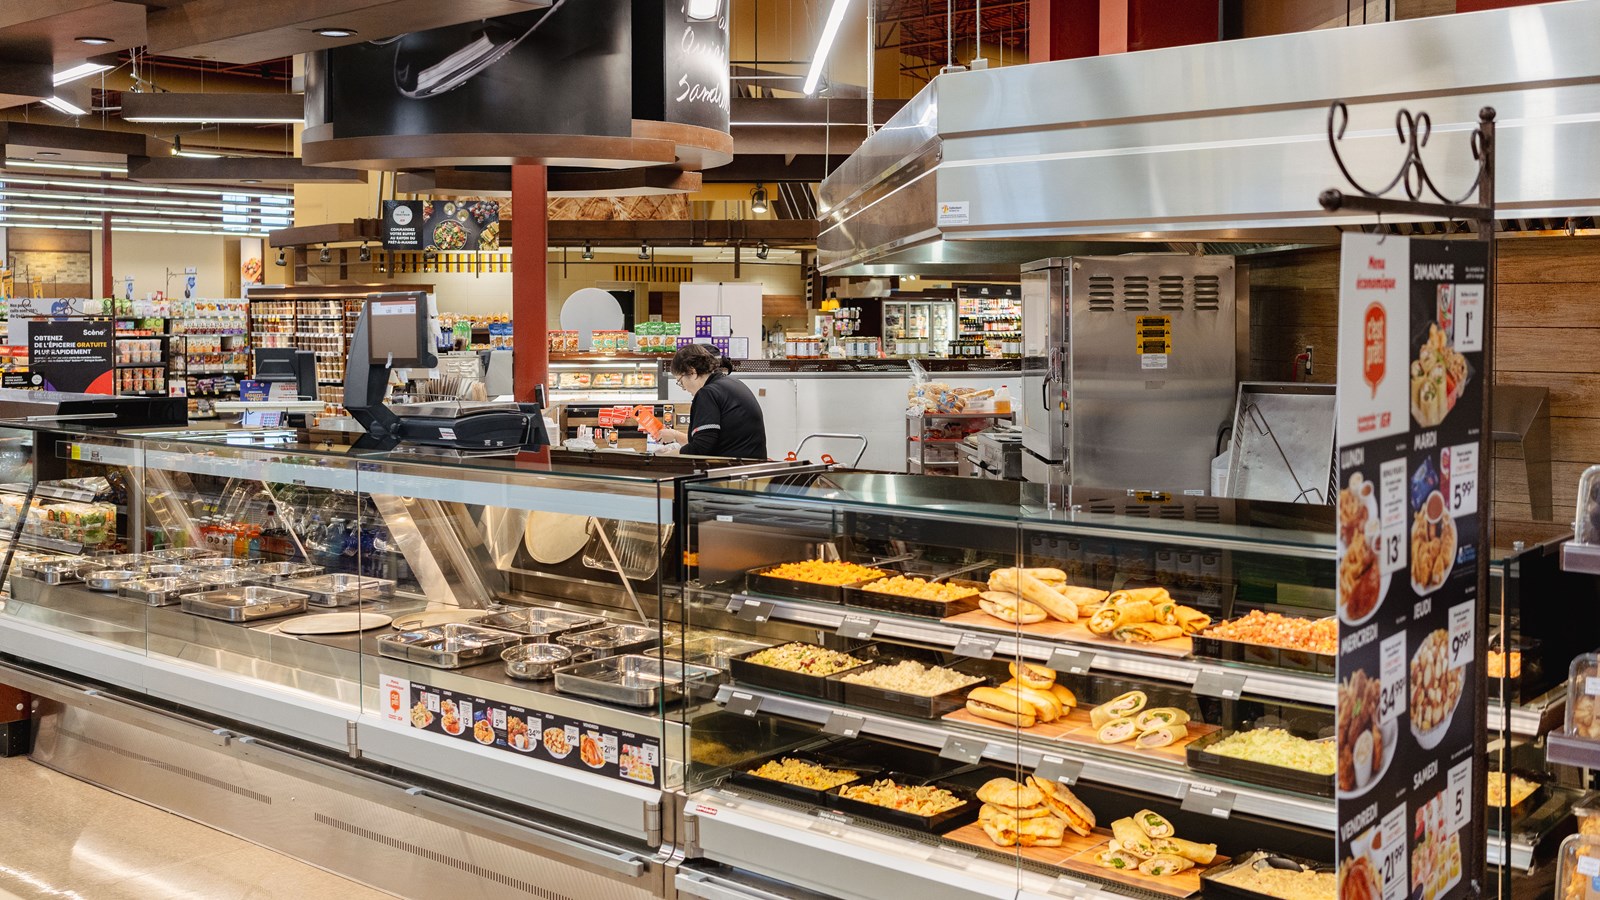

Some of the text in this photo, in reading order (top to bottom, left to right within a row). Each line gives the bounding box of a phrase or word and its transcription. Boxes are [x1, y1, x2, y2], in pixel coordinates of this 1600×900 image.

[1413, 263, 1455, 280] DIMANCHE
[1414, 431, 1437, 451] MARDI
[1341, 447, 1364, 470] LUNDI
[1413, 599, 1432, 620] JEUDI
[1341, 624, 1378, 656] MERCREDI
[1413, 760, 1438, 790] SAMEDI
[1340, 802, 1378, 843] VENDREDI
